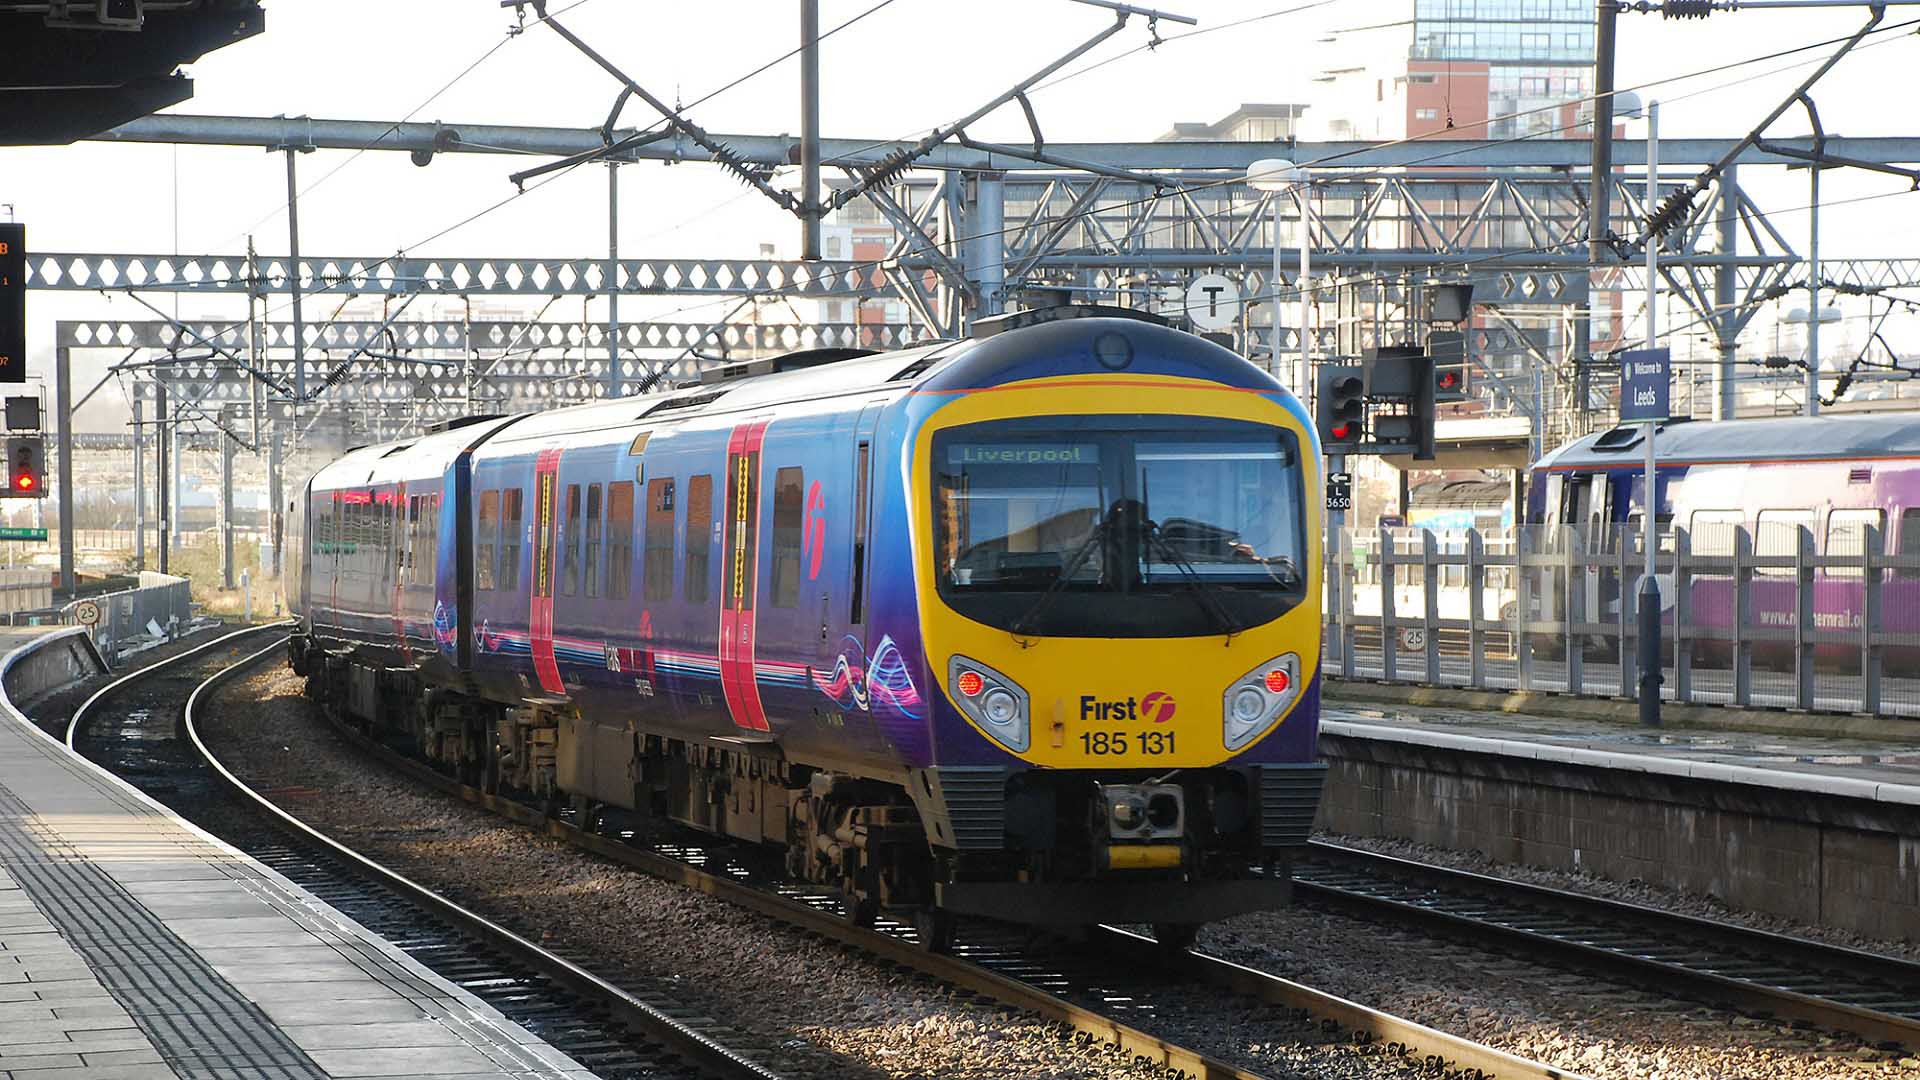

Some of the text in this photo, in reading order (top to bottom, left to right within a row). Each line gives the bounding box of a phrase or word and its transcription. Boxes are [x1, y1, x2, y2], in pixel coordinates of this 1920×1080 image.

[1202, 286, 1224, 317] T
[1634, 361, 1663, 375] Welcome to
[1634, 385, 1656, 406] Leeds
[964, 447, 1081, 463] Liverpool
[1335, 486, 1343, 496] L
[1327, 497, 1351, 508] 3650
[80, 606, 95, 619] 25
[1407, 631, 1423, 644] 25
[1080, 695, 1137, 721] First
[1080, 731, 1175, 755] 185 131
